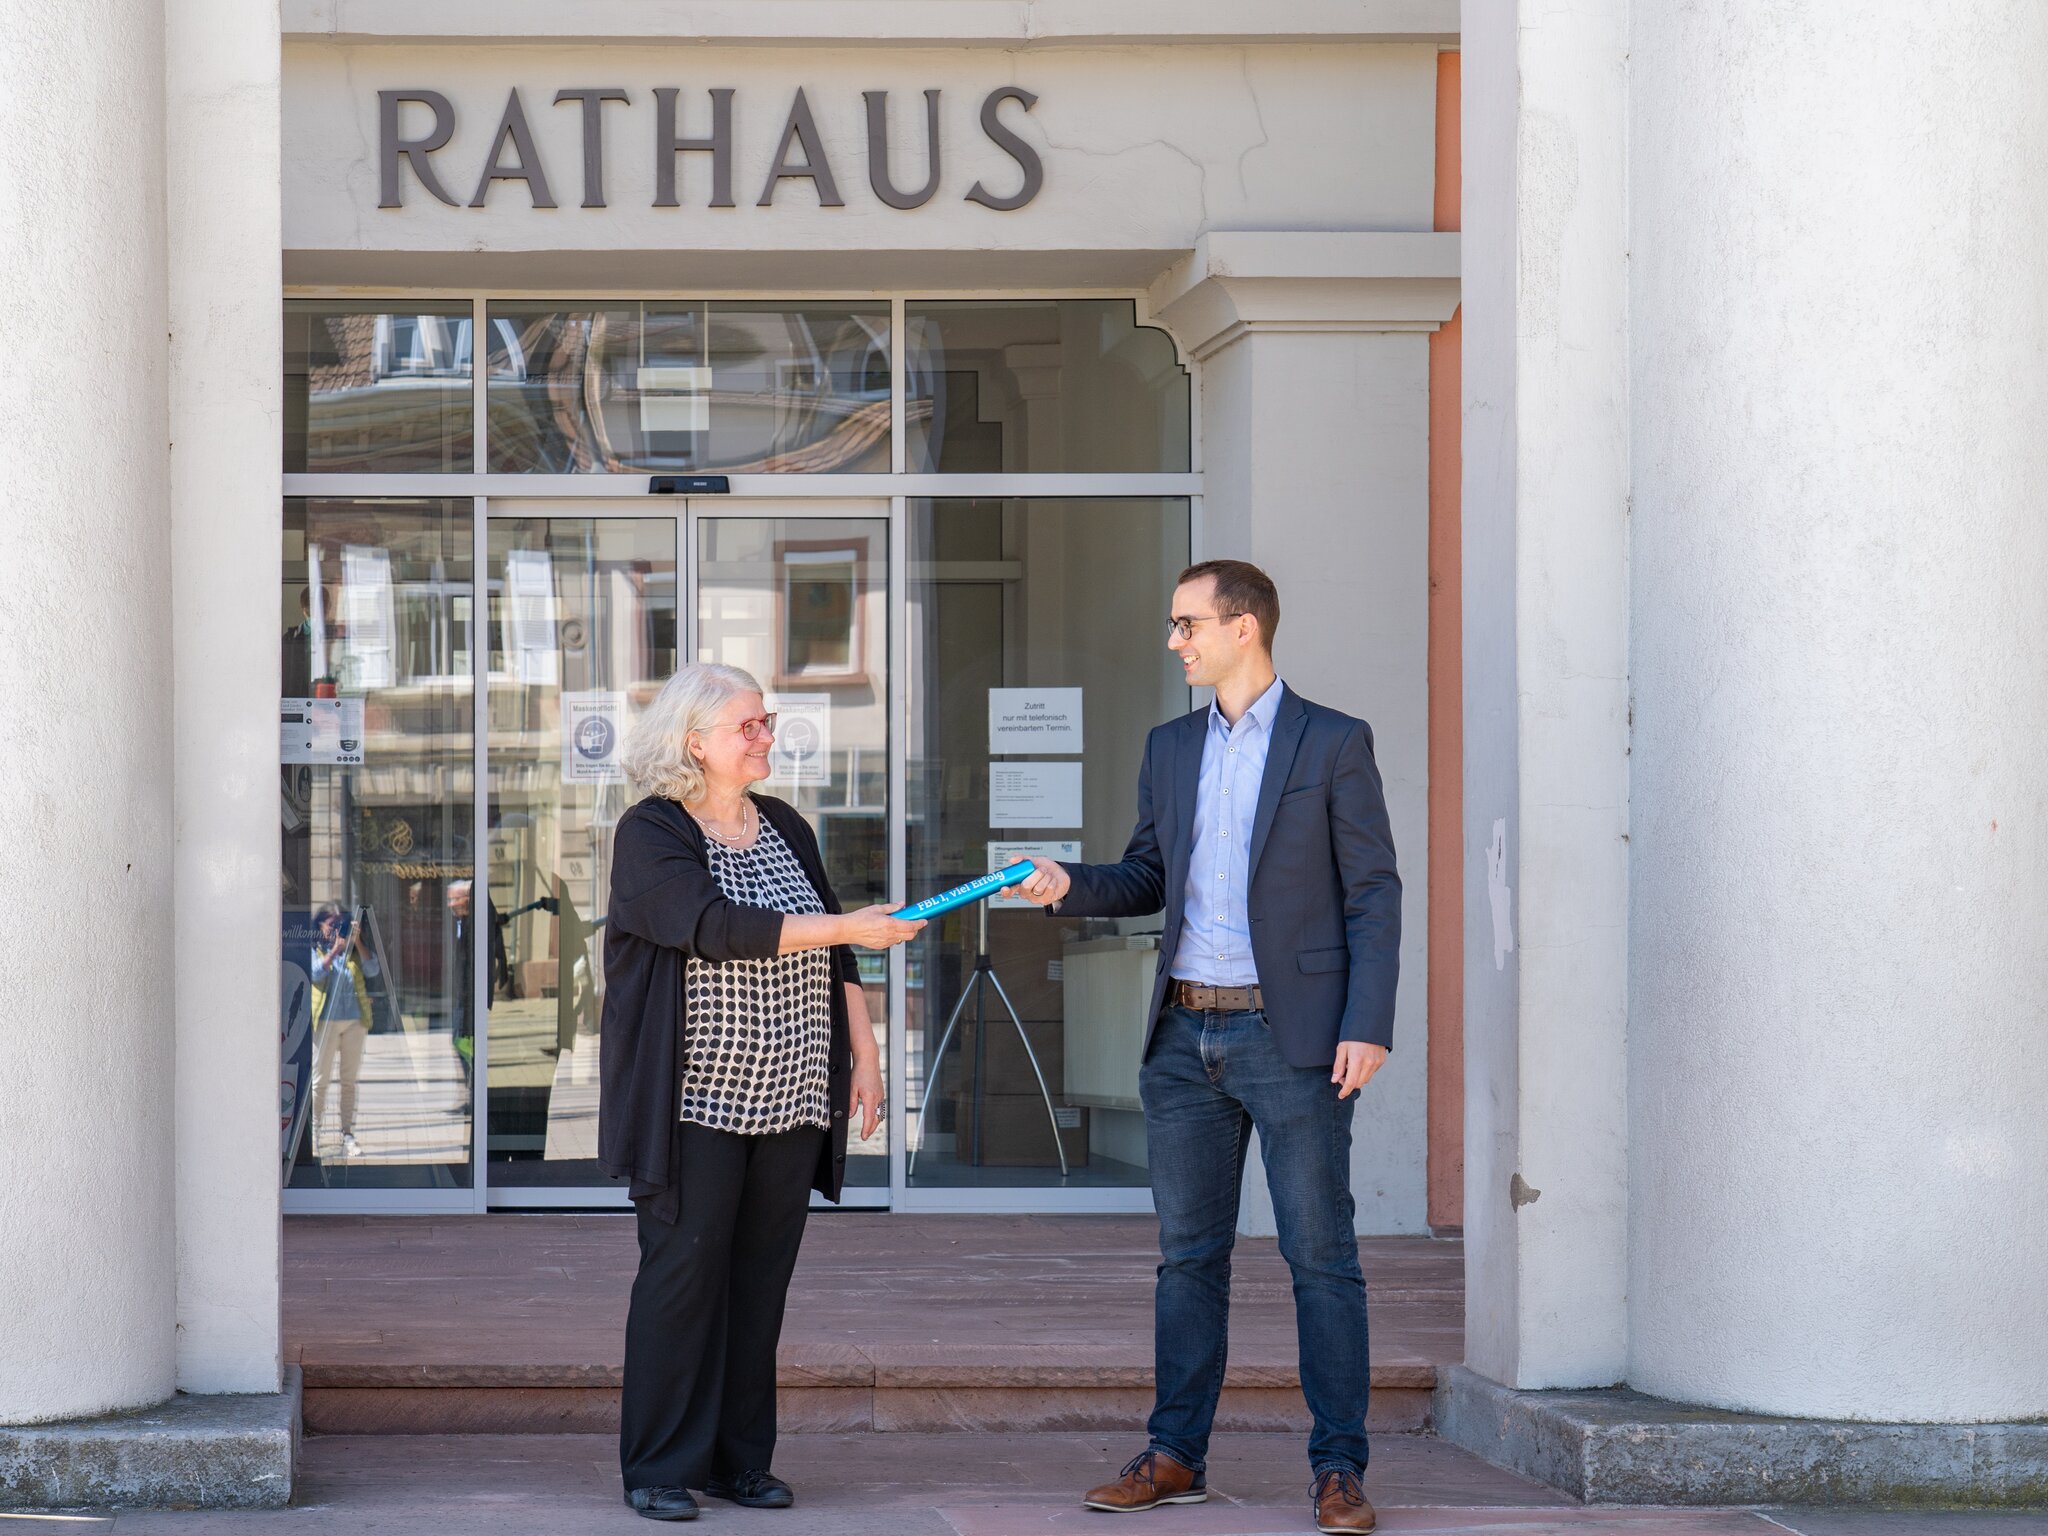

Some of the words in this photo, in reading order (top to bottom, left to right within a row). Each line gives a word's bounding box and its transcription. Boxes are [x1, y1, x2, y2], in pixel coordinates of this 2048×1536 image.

[377, 86, 1043, 211] RATHAUS
[573, 704, 617, 713] Maskenpflicht
[1024, 702, 1046, 710] Zutritt
[1028, 713, 1068, 721] telefonisch
[997, 724, 1044, 732] vereinbartem
[1046, 724, 1072, 732] Termin.
[916, 896, 940, 911] FBL
[970, 871, 1005, 889] Erfolg
